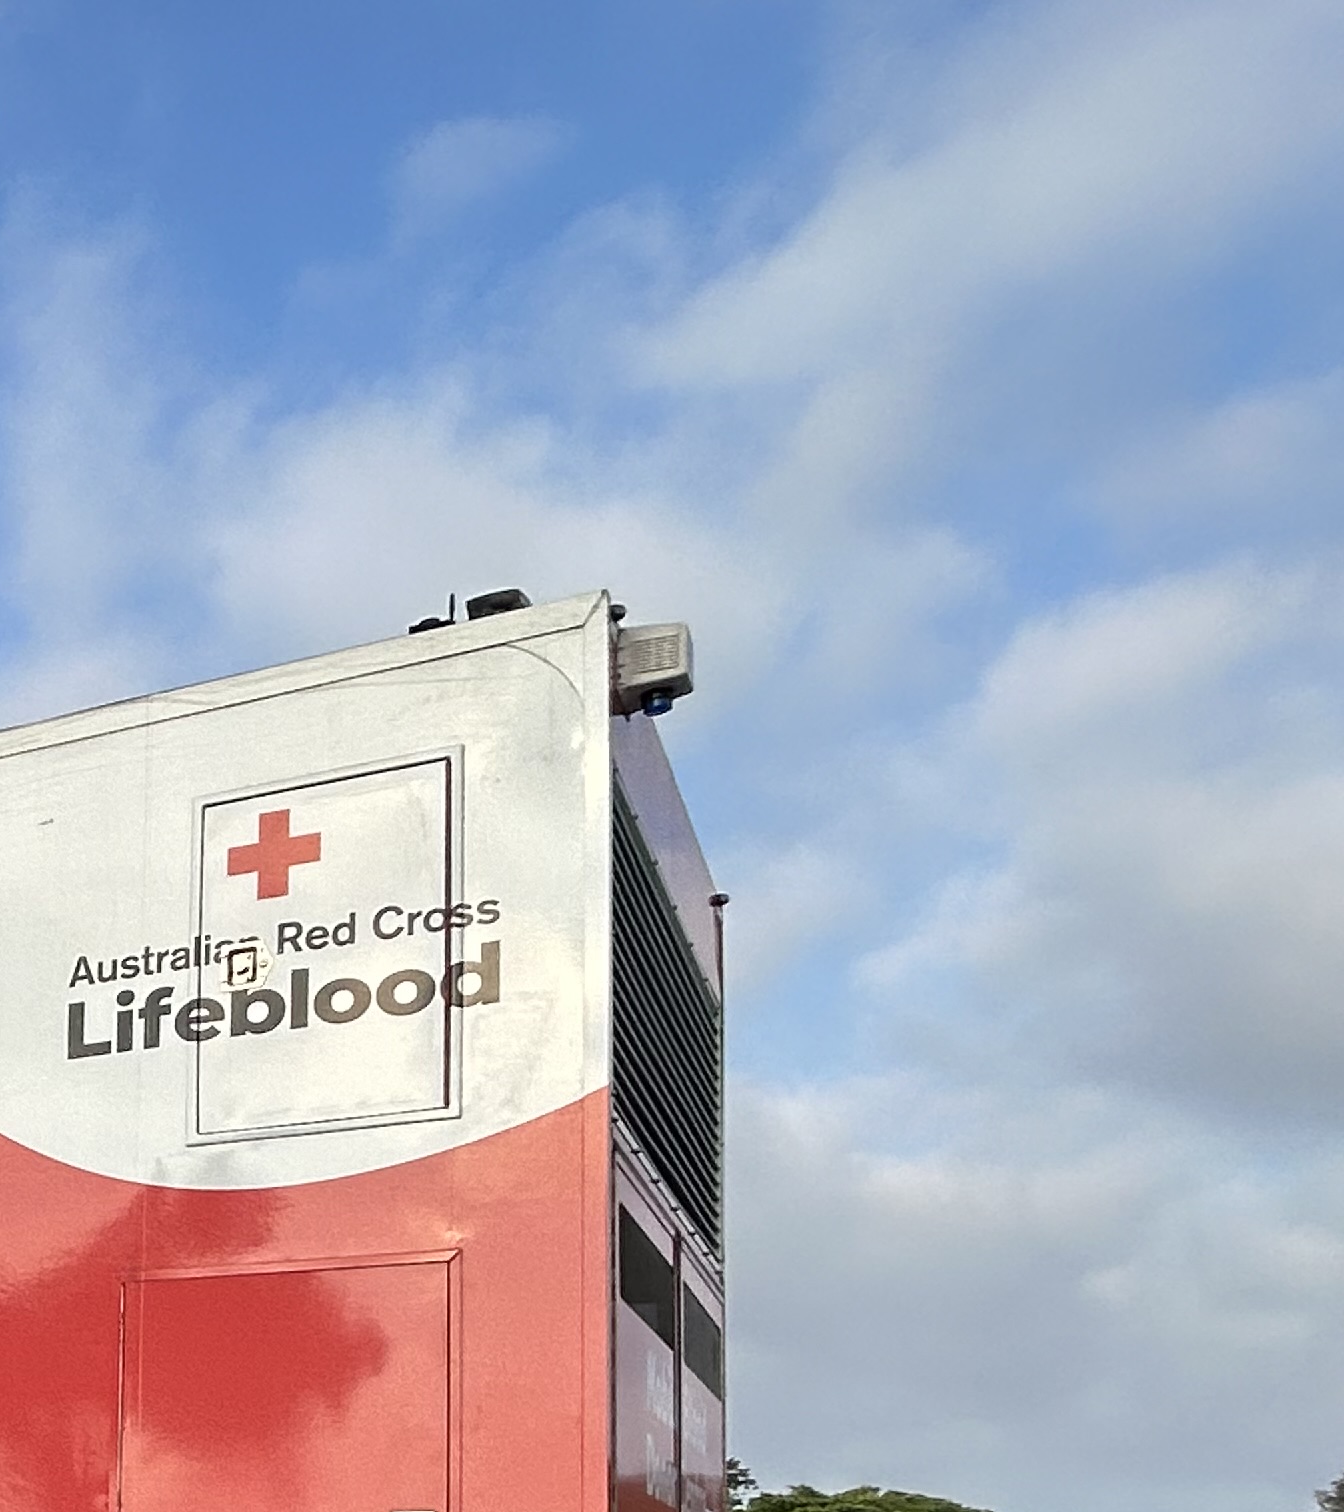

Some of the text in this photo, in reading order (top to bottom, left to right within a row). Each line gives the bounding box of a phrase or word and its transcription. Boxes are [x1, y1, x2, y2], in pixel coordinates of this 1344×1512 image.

[69, 899, 501, 988] Australi Red Cross
[67, 940, 501, 1060] Lifeblood
